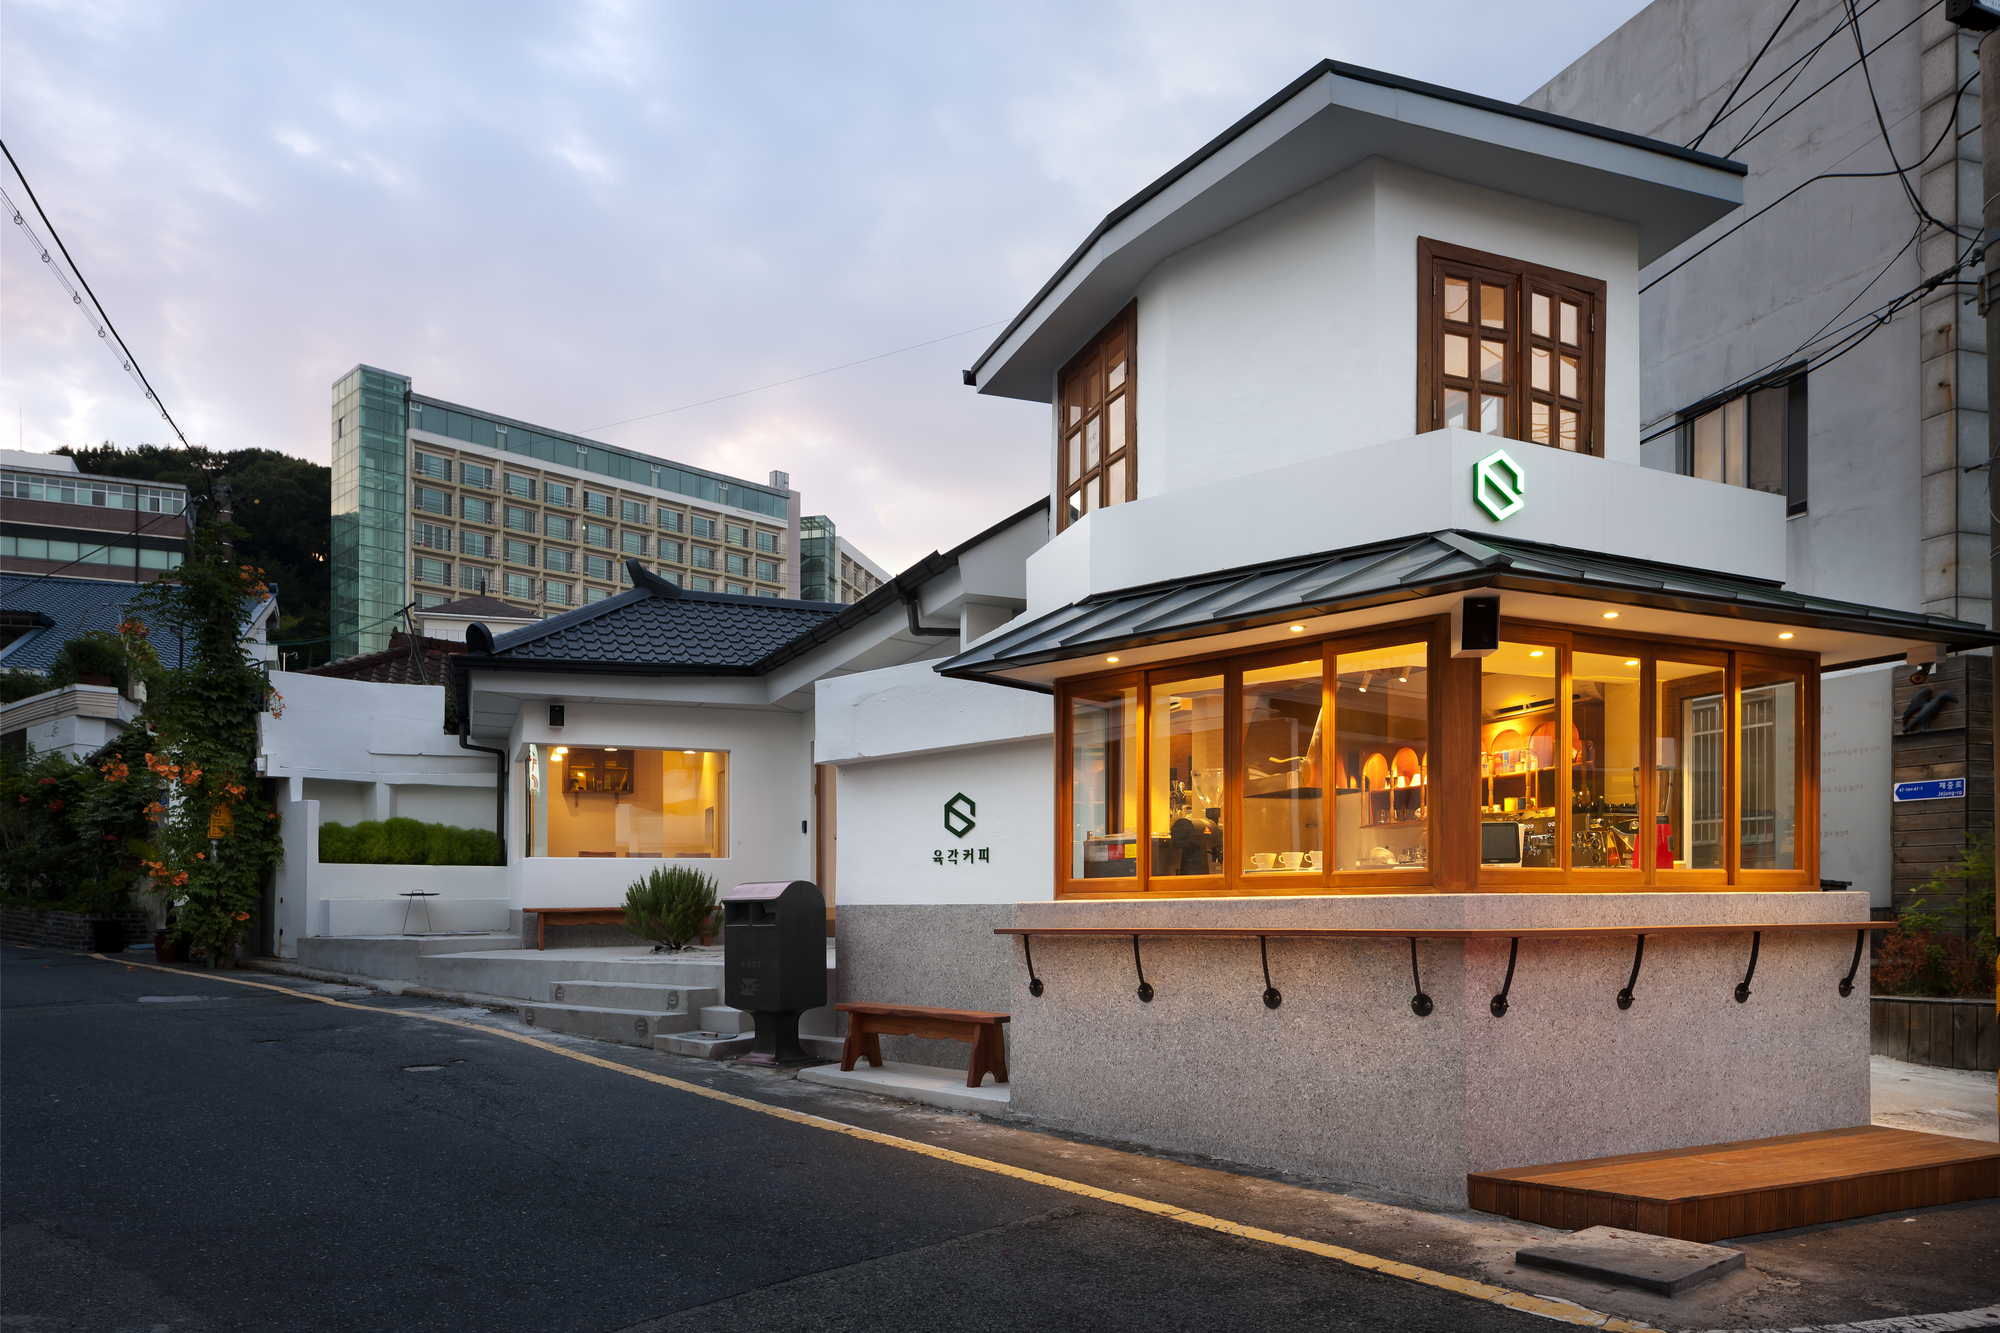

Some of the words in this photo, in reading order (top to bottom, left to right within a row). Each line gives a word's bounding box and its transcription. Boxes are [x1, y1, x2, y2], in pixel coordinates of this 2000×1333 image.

[1938, 780, 1962, 789] 제중로
[931, 846, 989, 865] 육각커피
[741, 960, 762, 969] POST
